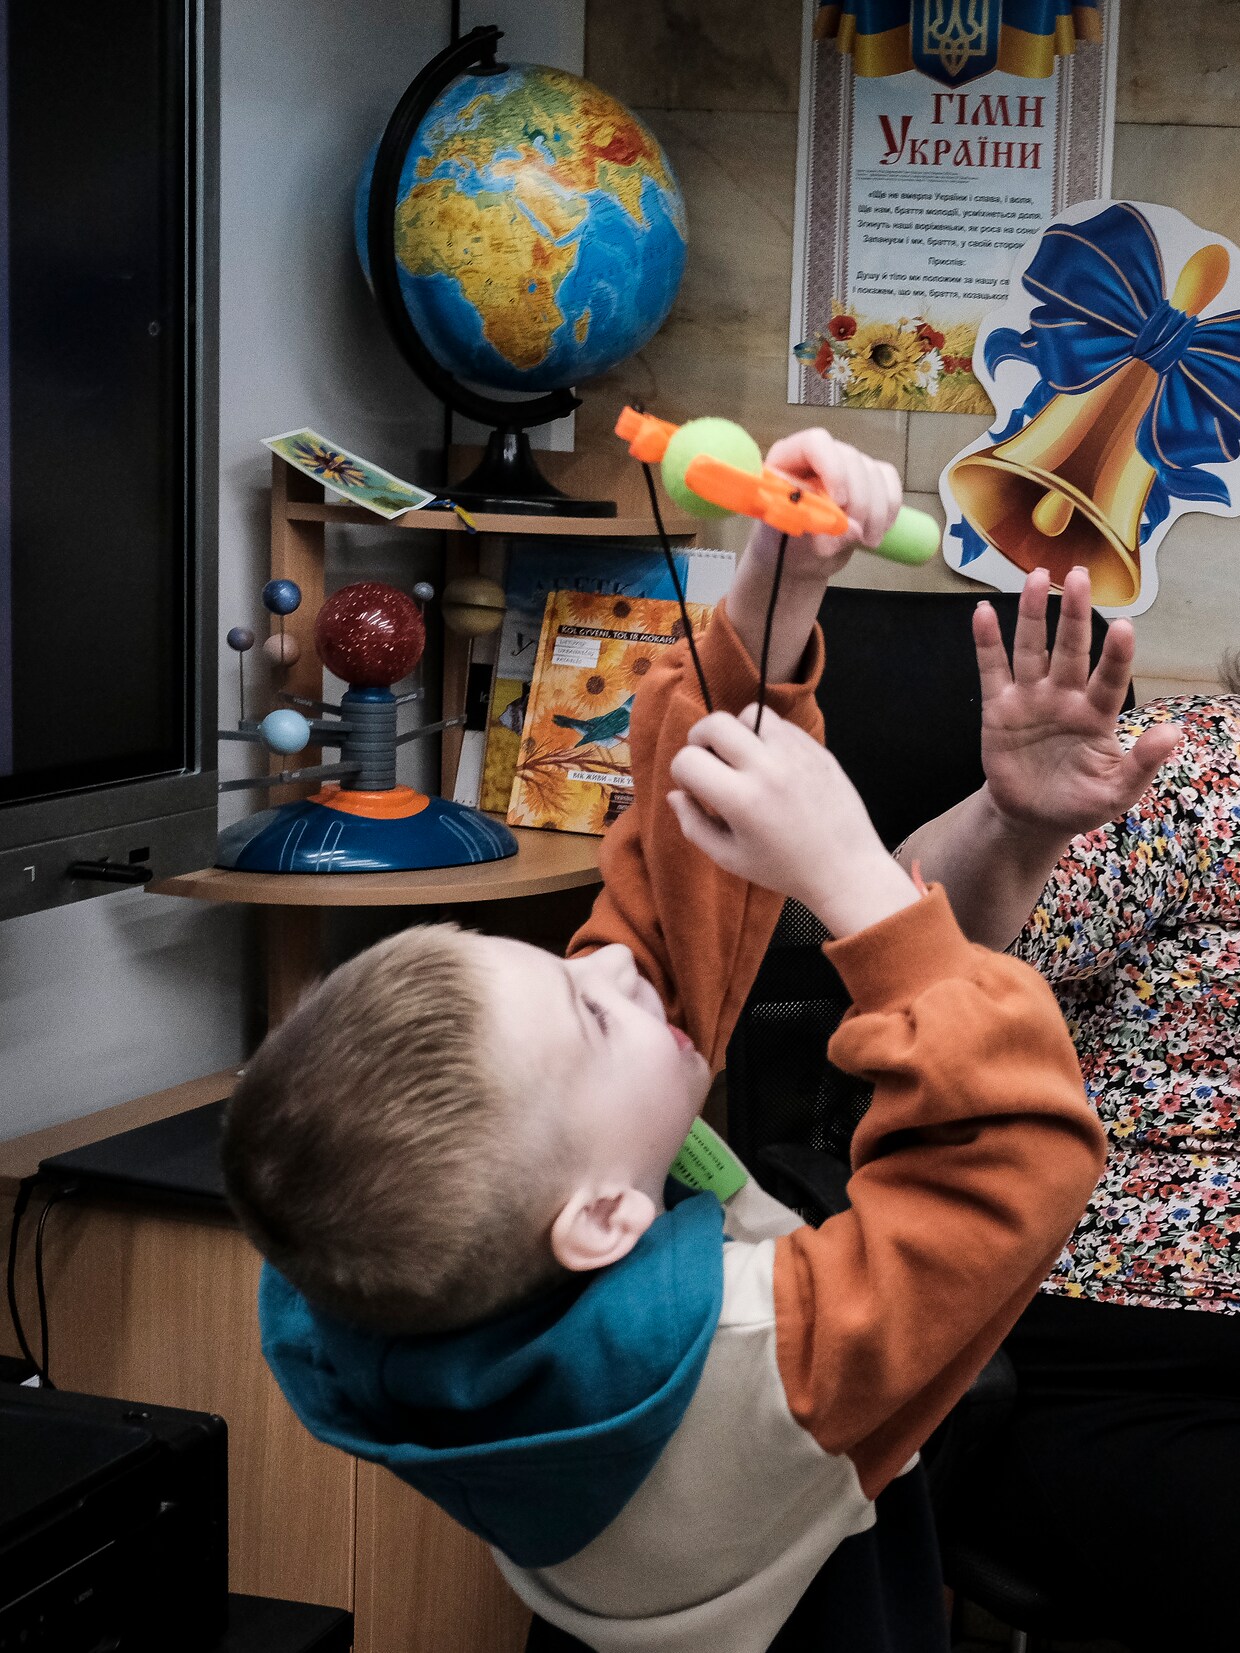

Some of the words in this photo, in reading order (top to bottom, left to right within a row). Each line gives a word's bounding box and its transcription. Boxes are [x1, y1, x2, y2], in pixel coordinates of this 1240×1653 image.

[930, 93, 1046, 128] ГІМН
[1004, 195, 1008, 203] і
[858, 204, 872, 213] Ще
[894, 206, 924, 216] браття
[857, 219, 891, 230] Згинуть
[980, 226, 1002, 234] роса
[905, 236, 909, 244] і
[928, 256, 967, 266] Приспів:
[856, 270, 880, 281] Душу
[889, 272, 907, 280] тіло
[922, 275, 962, 283] положим
[975, 278, 998, 286] нашу
[561, 626, 577, 635] KOL
[613, 631, 628, 639] TOL
